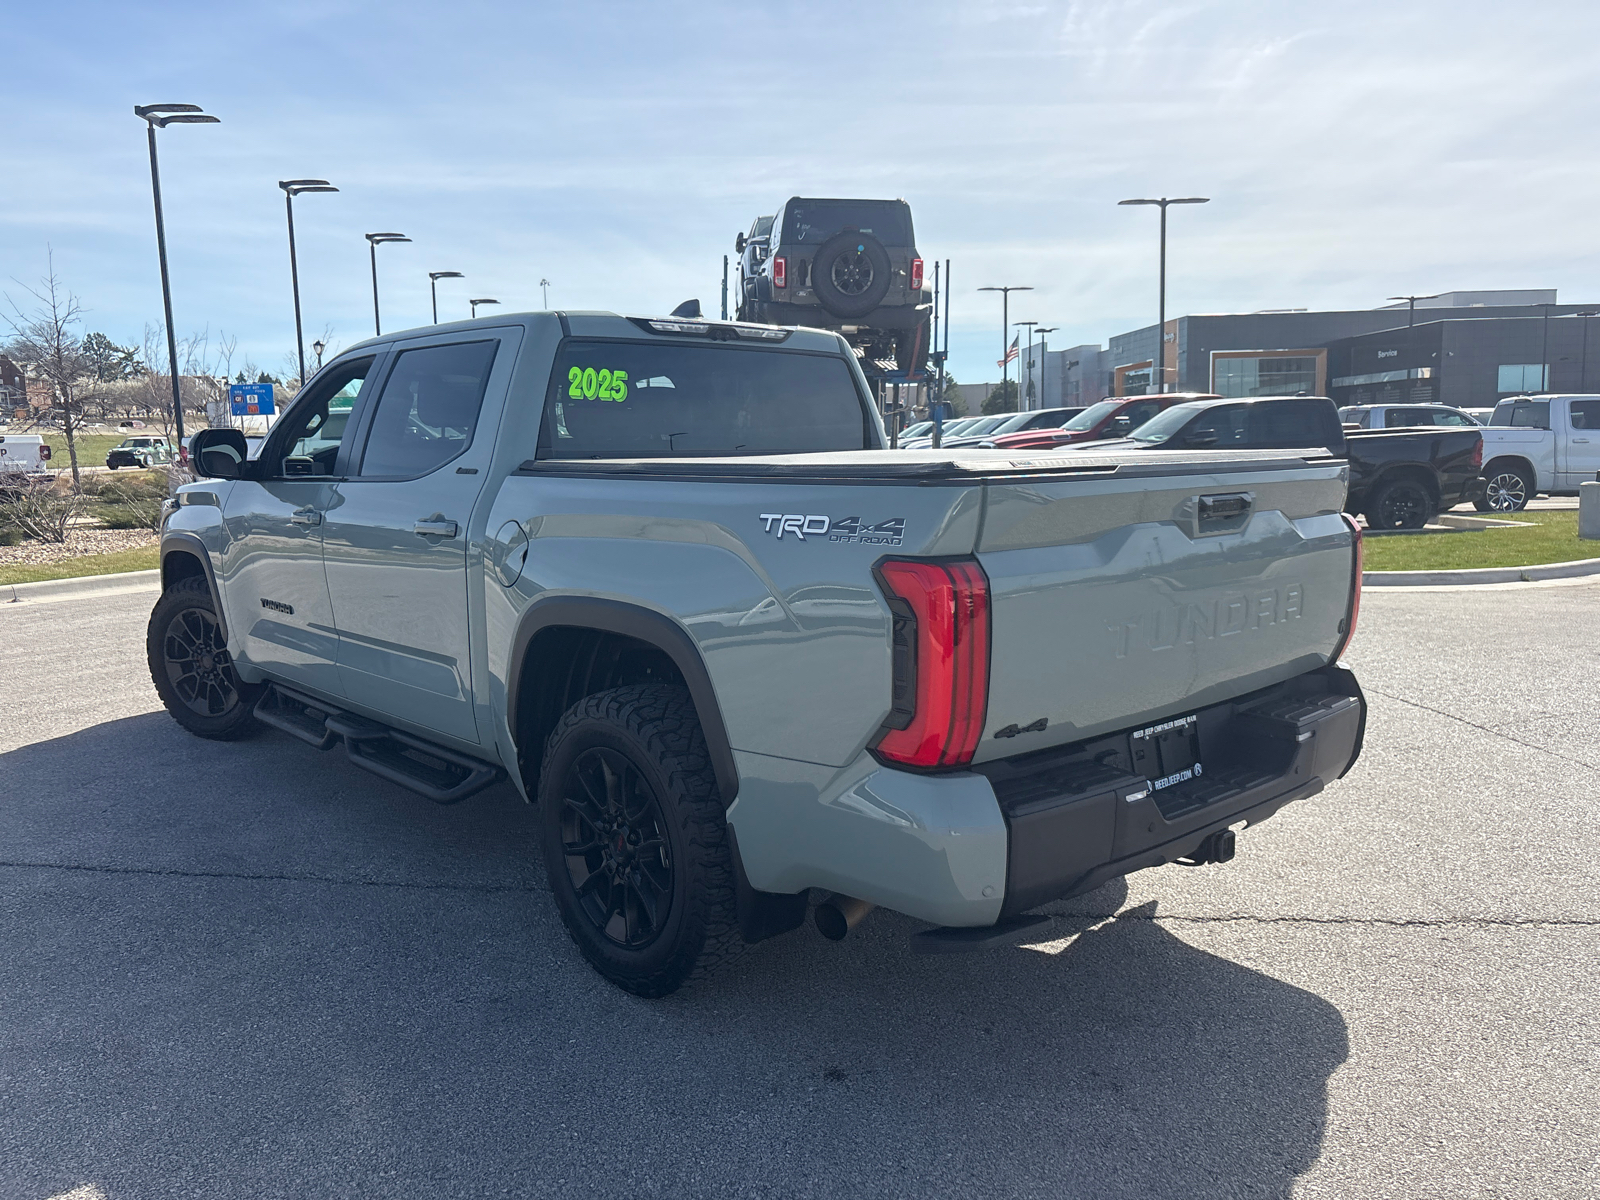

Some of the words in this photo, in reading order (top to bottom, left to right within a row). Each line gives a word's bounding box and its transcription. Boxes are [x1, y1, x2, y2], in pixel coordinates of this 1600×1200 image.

[1377, 349, 1398, 359] Service
[568, 366, 628, 402] 2025
[759, 513, 830, 541] TRD
[831, 516, 906, 538] 4x4
[829, 535, 858, 543] OFF
[859, 536, 903, 546] ROAD
[260, 597, 294, 615] TUNDRA
[1103, 584, 1304, 659] TUNDRA
[1133, 730, 1144, 739] REED
[1144, 727, 1154, 736] JEEP
[1154, 721, 1174, 733] CHRYSLER
[1174, 717, 1187, 727] DODGE
[1154, 769, 1193, 790] REEDJEEP.COM
